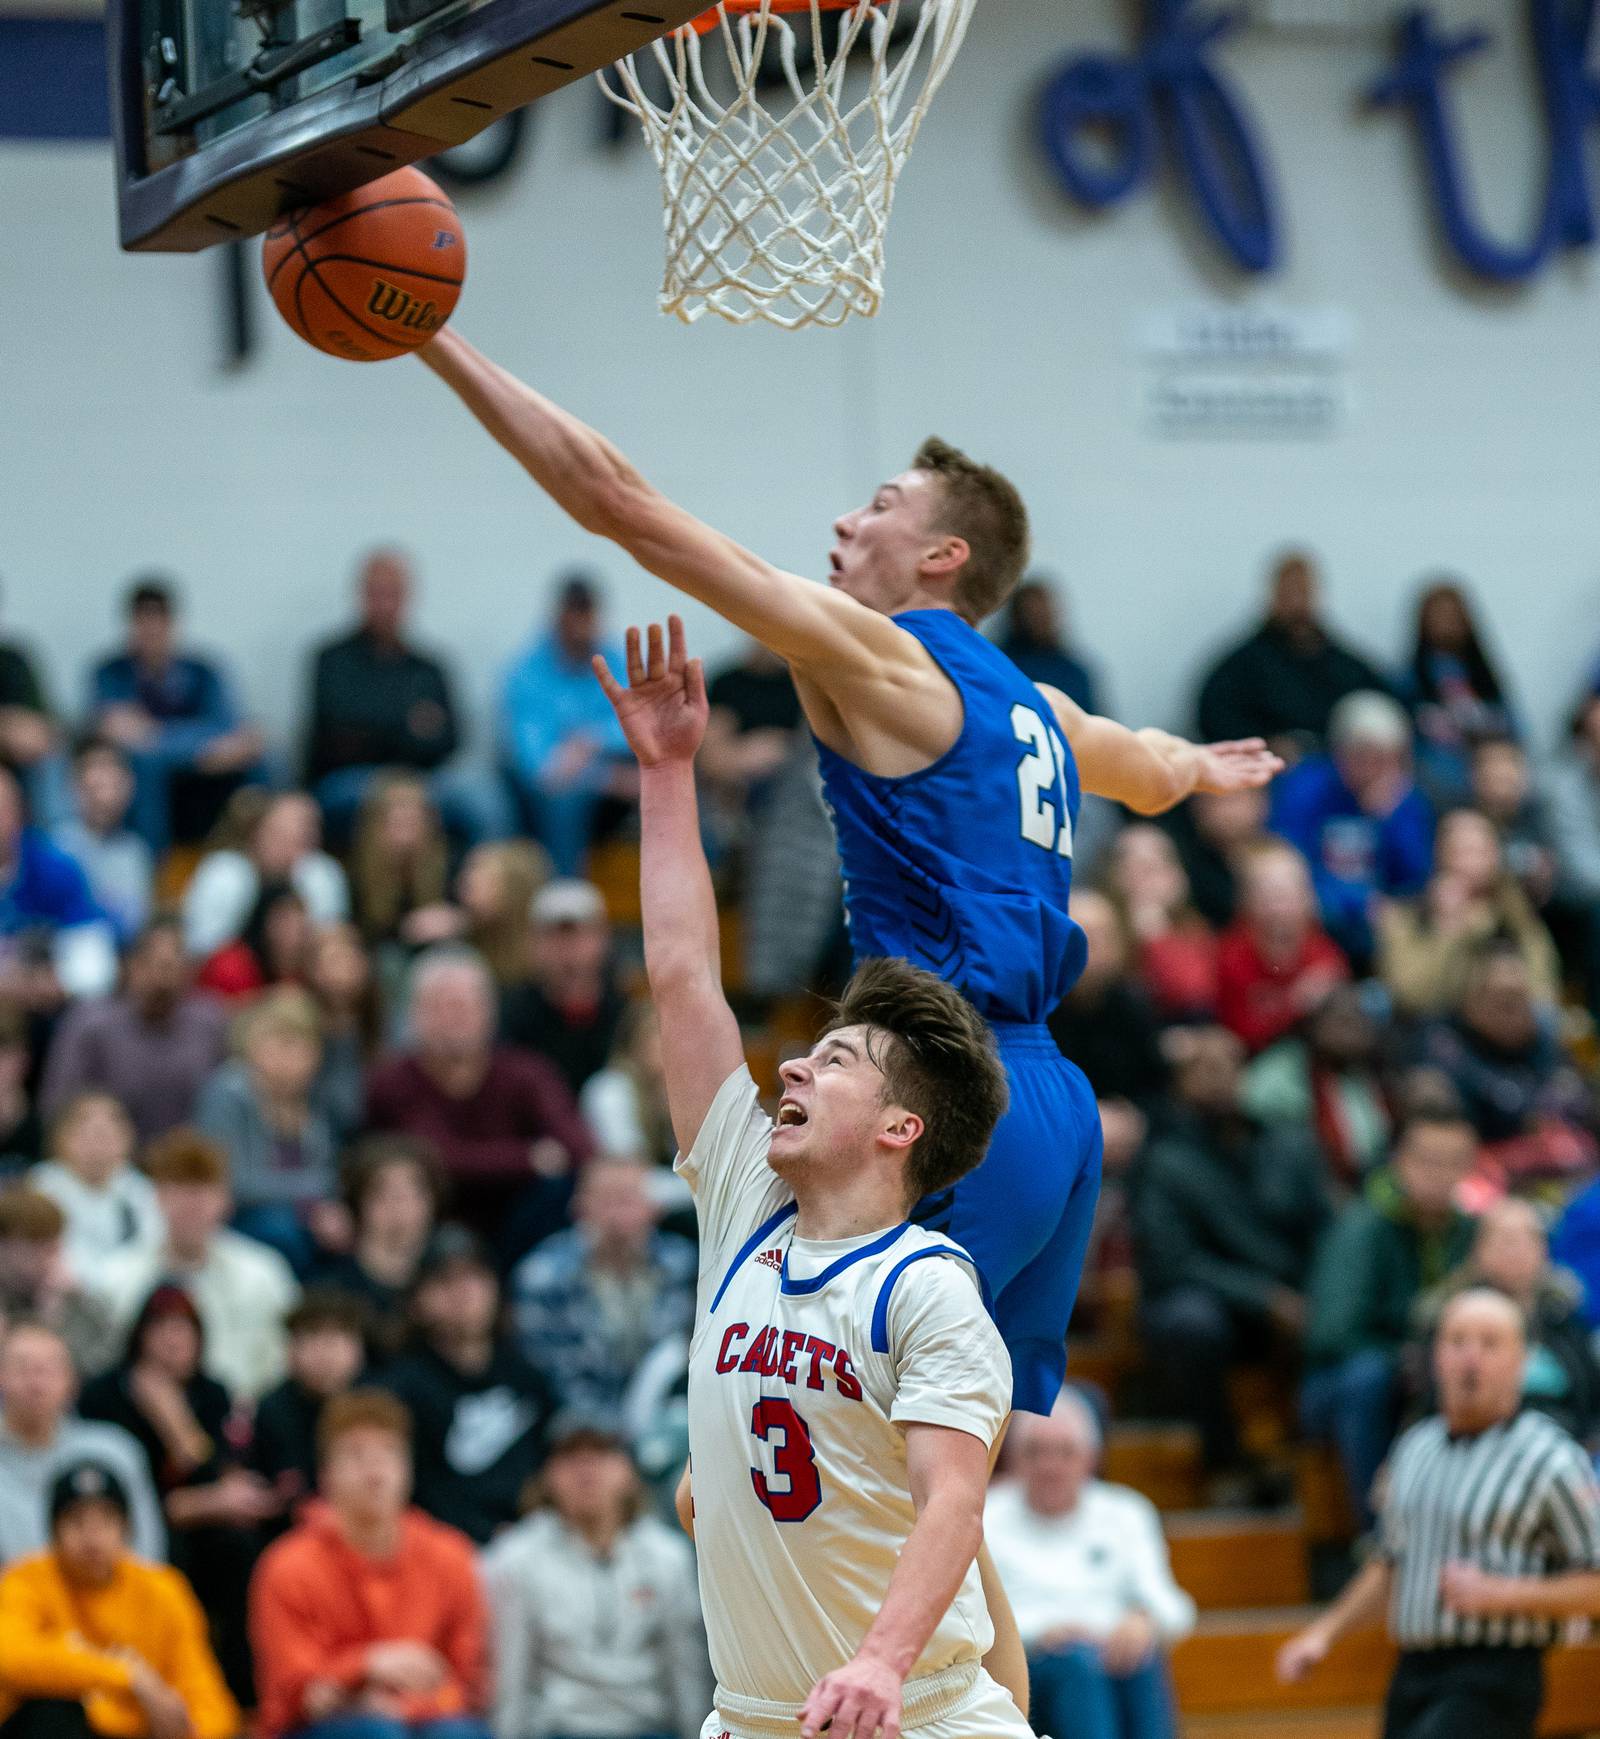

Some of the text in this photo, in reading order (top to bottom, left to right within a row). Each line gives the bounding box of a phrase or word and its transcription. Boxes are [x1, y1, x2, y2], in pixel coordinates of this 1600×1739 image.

[432, 231, 457, 249] P
[367, 277, 450, 331] Wils
[1010, 702, 1073, 860] 21
[715, 1322, 863, 1402] CADETS
[751, 1396, 823, 1523] 3
